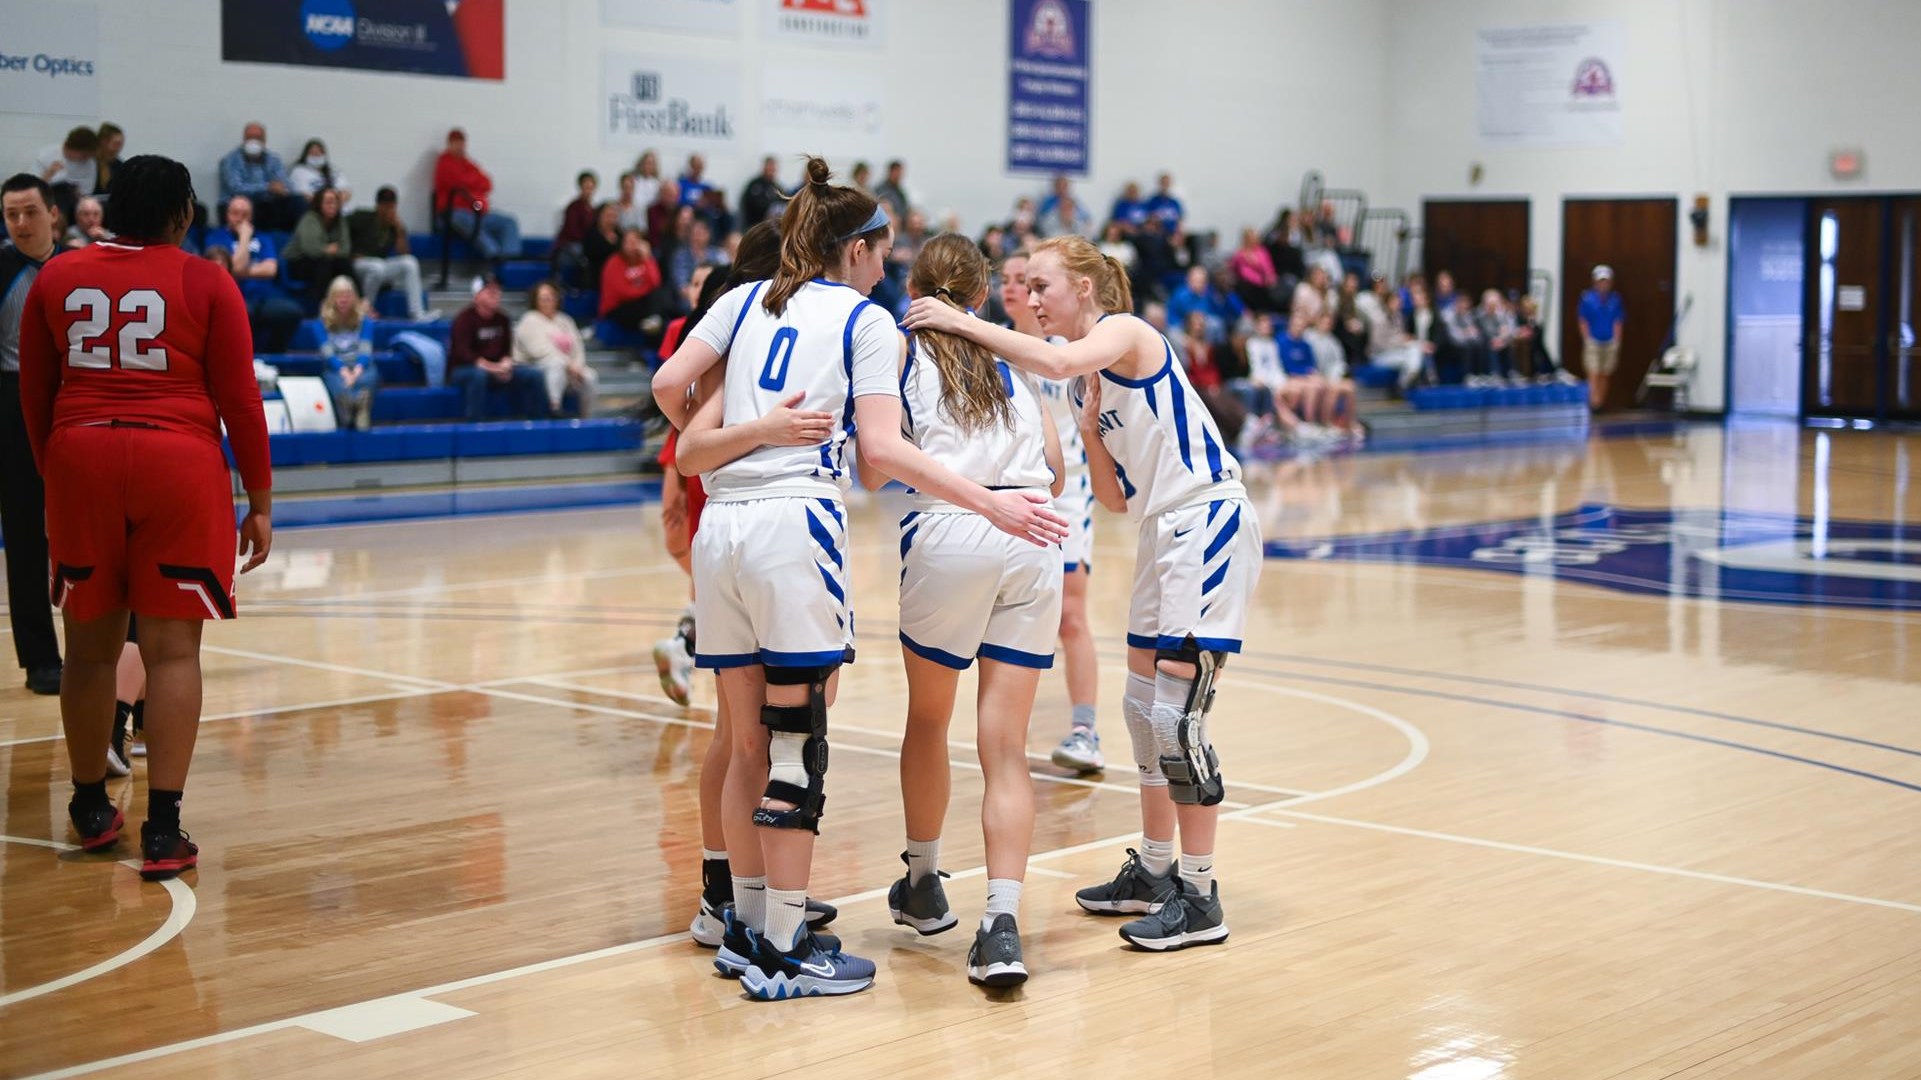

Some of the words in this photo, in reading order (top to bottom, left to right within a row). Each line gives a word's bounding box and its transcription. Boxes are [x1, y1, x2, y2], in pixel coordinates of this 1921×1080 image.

[306, 13, 353, 37] NCAA
[33, 54, 93, 78] Optics
[608, 94, 735, 140] FirstBank
[64, 287, 167, 370] 22
[759, 327, 798, 392] 0
